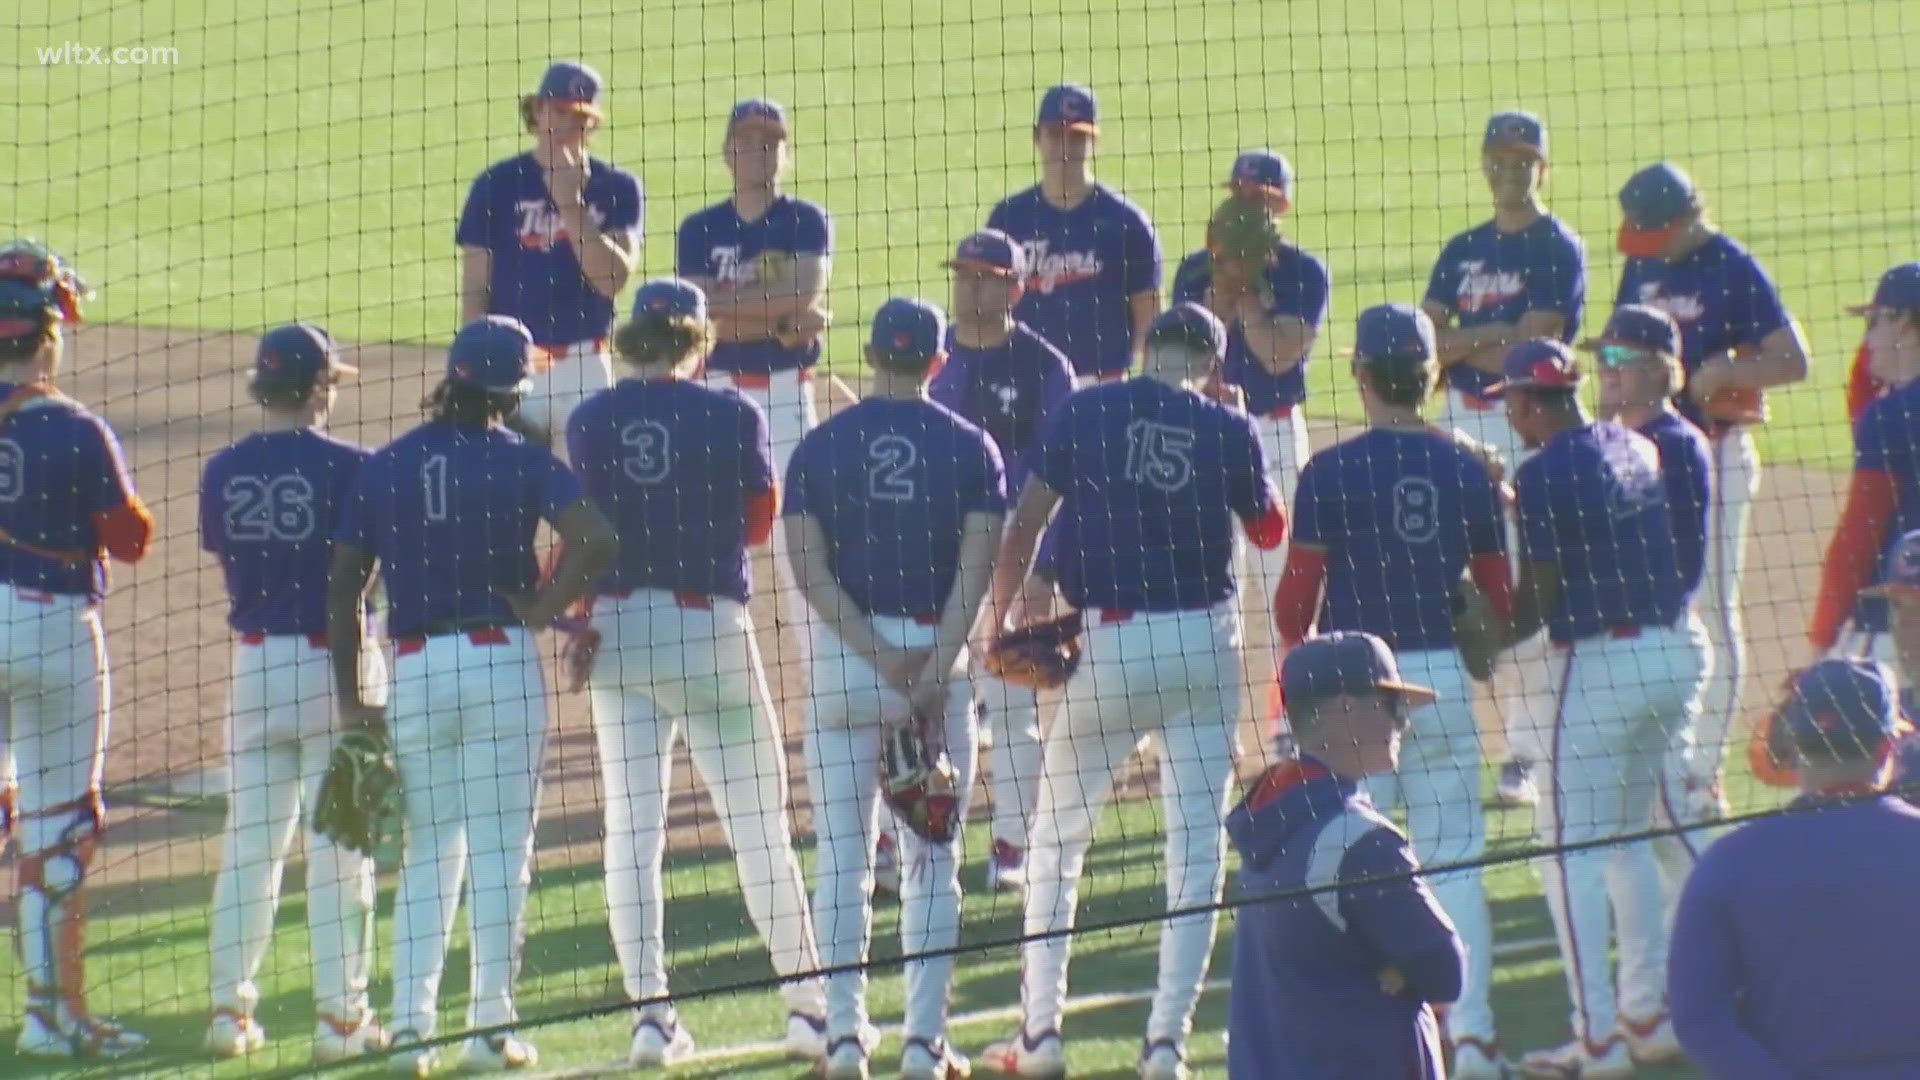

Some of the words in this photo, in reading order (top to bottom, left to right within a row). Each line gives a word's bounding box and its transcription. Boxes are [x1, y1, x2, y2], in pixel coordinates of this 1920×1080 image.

[621, 420, 670, 483] 3
[869, 434, 917, 500] 2
[1125, 419, 1196, 492] 15
[224, 475, 316, 541] 26
[423, 455, 447, 520] 1
[1393, 477, 1439, 542] 8
